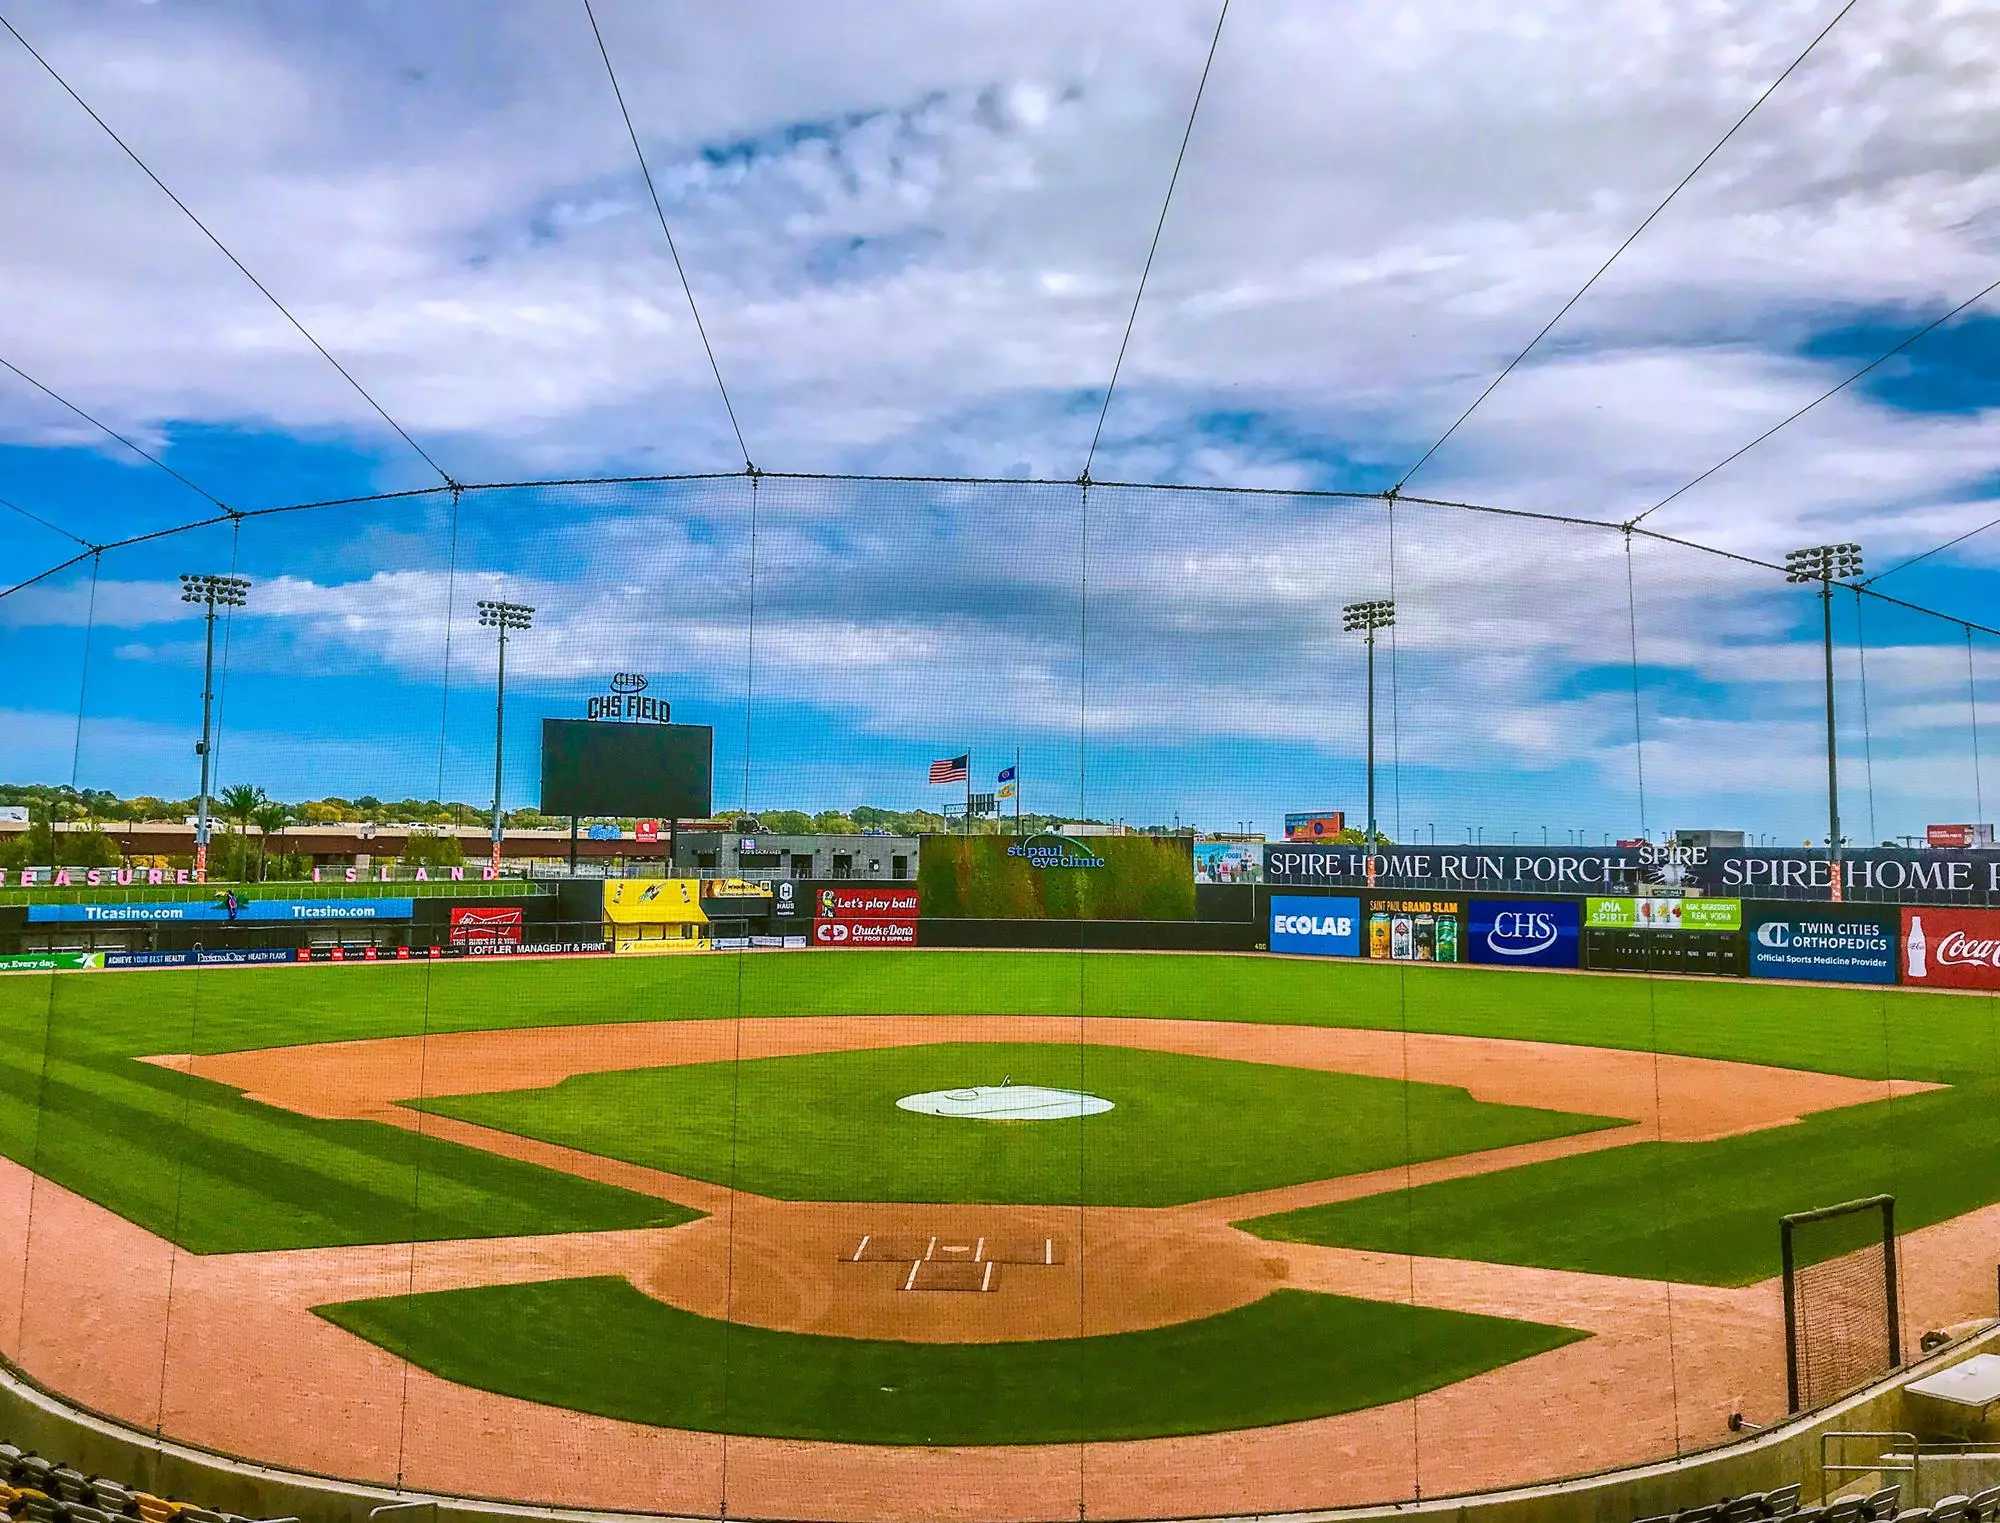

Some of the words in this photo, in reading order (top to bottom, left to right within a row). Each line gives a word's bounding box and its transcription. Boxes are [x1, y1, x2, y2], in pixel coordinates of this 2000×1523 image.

[613, 671, 646, 688] CHS
[588, 695, 621, 720] CHS
[627, 695, 670, 723] FIELD
[1027, 844, 1063, 858] paul
[1638, 846, 1708, 867] SPIRE
[1031, 856, 1058, 869] eye
[1060, 855, 1105, 868] clinic
[1270, 853, 1342, 877] SPIRE
[1350, 854, 1432, 878] HOME
[1441, 855, 1504, 880] RUN
[1514, 856, 1627, 884] PORCH
[1722, 859, 1832, 889] SPIRE
[1846, 860, 1974, 891] HOME
[837, 897, 867, 908] Let's
[865, 897, 890, 911] play
[891, 897, 917, 908] ball!
[1370, 900, 1386, 911] SAINT
[1387, 901, 1401, 912] PAUL
[1402, 901, 1431, 912] GRAND
[1432, 902, 1458, 913] SLAM
[1592, 913, 1629, 923] SPIRIT
[1274, 915, 1352, 936] ECOLAB
[1494, 912, 1551, 939] CHS
[1799, 922, 1834, 935] TWIN
[1837, 923, 1880, 936] CITIES
[469, 946, 512, 955] LOFFLER
[517, 944, 563, 954] MANAGED
[563, 944, 570, 952] IT
[572, 944, 580, 952] &
[581, 942, 606, 952] PRINT
[1792, 936, 1887, 951] ORTHOPEDICS
[108, 955, 132, 965] ACHIEVE
[134, 954, 149, 964] YOUR
[149, 954, 163, 964] BEST
[164, 953, 187, 963] HEALTH
[248, 952, 268, 961] HEALTH
[269, 951, 287, 961] PLANS
[1757, 953, 1785, 963] Official
[1786, 954, 1812, 965] Sports
[1813, 955, 1850, 966] Medicine
[1851, 957, 1888, 968] Provider
[12, 960, 40, 971] Every
[40, 957, 57, 968] day.
